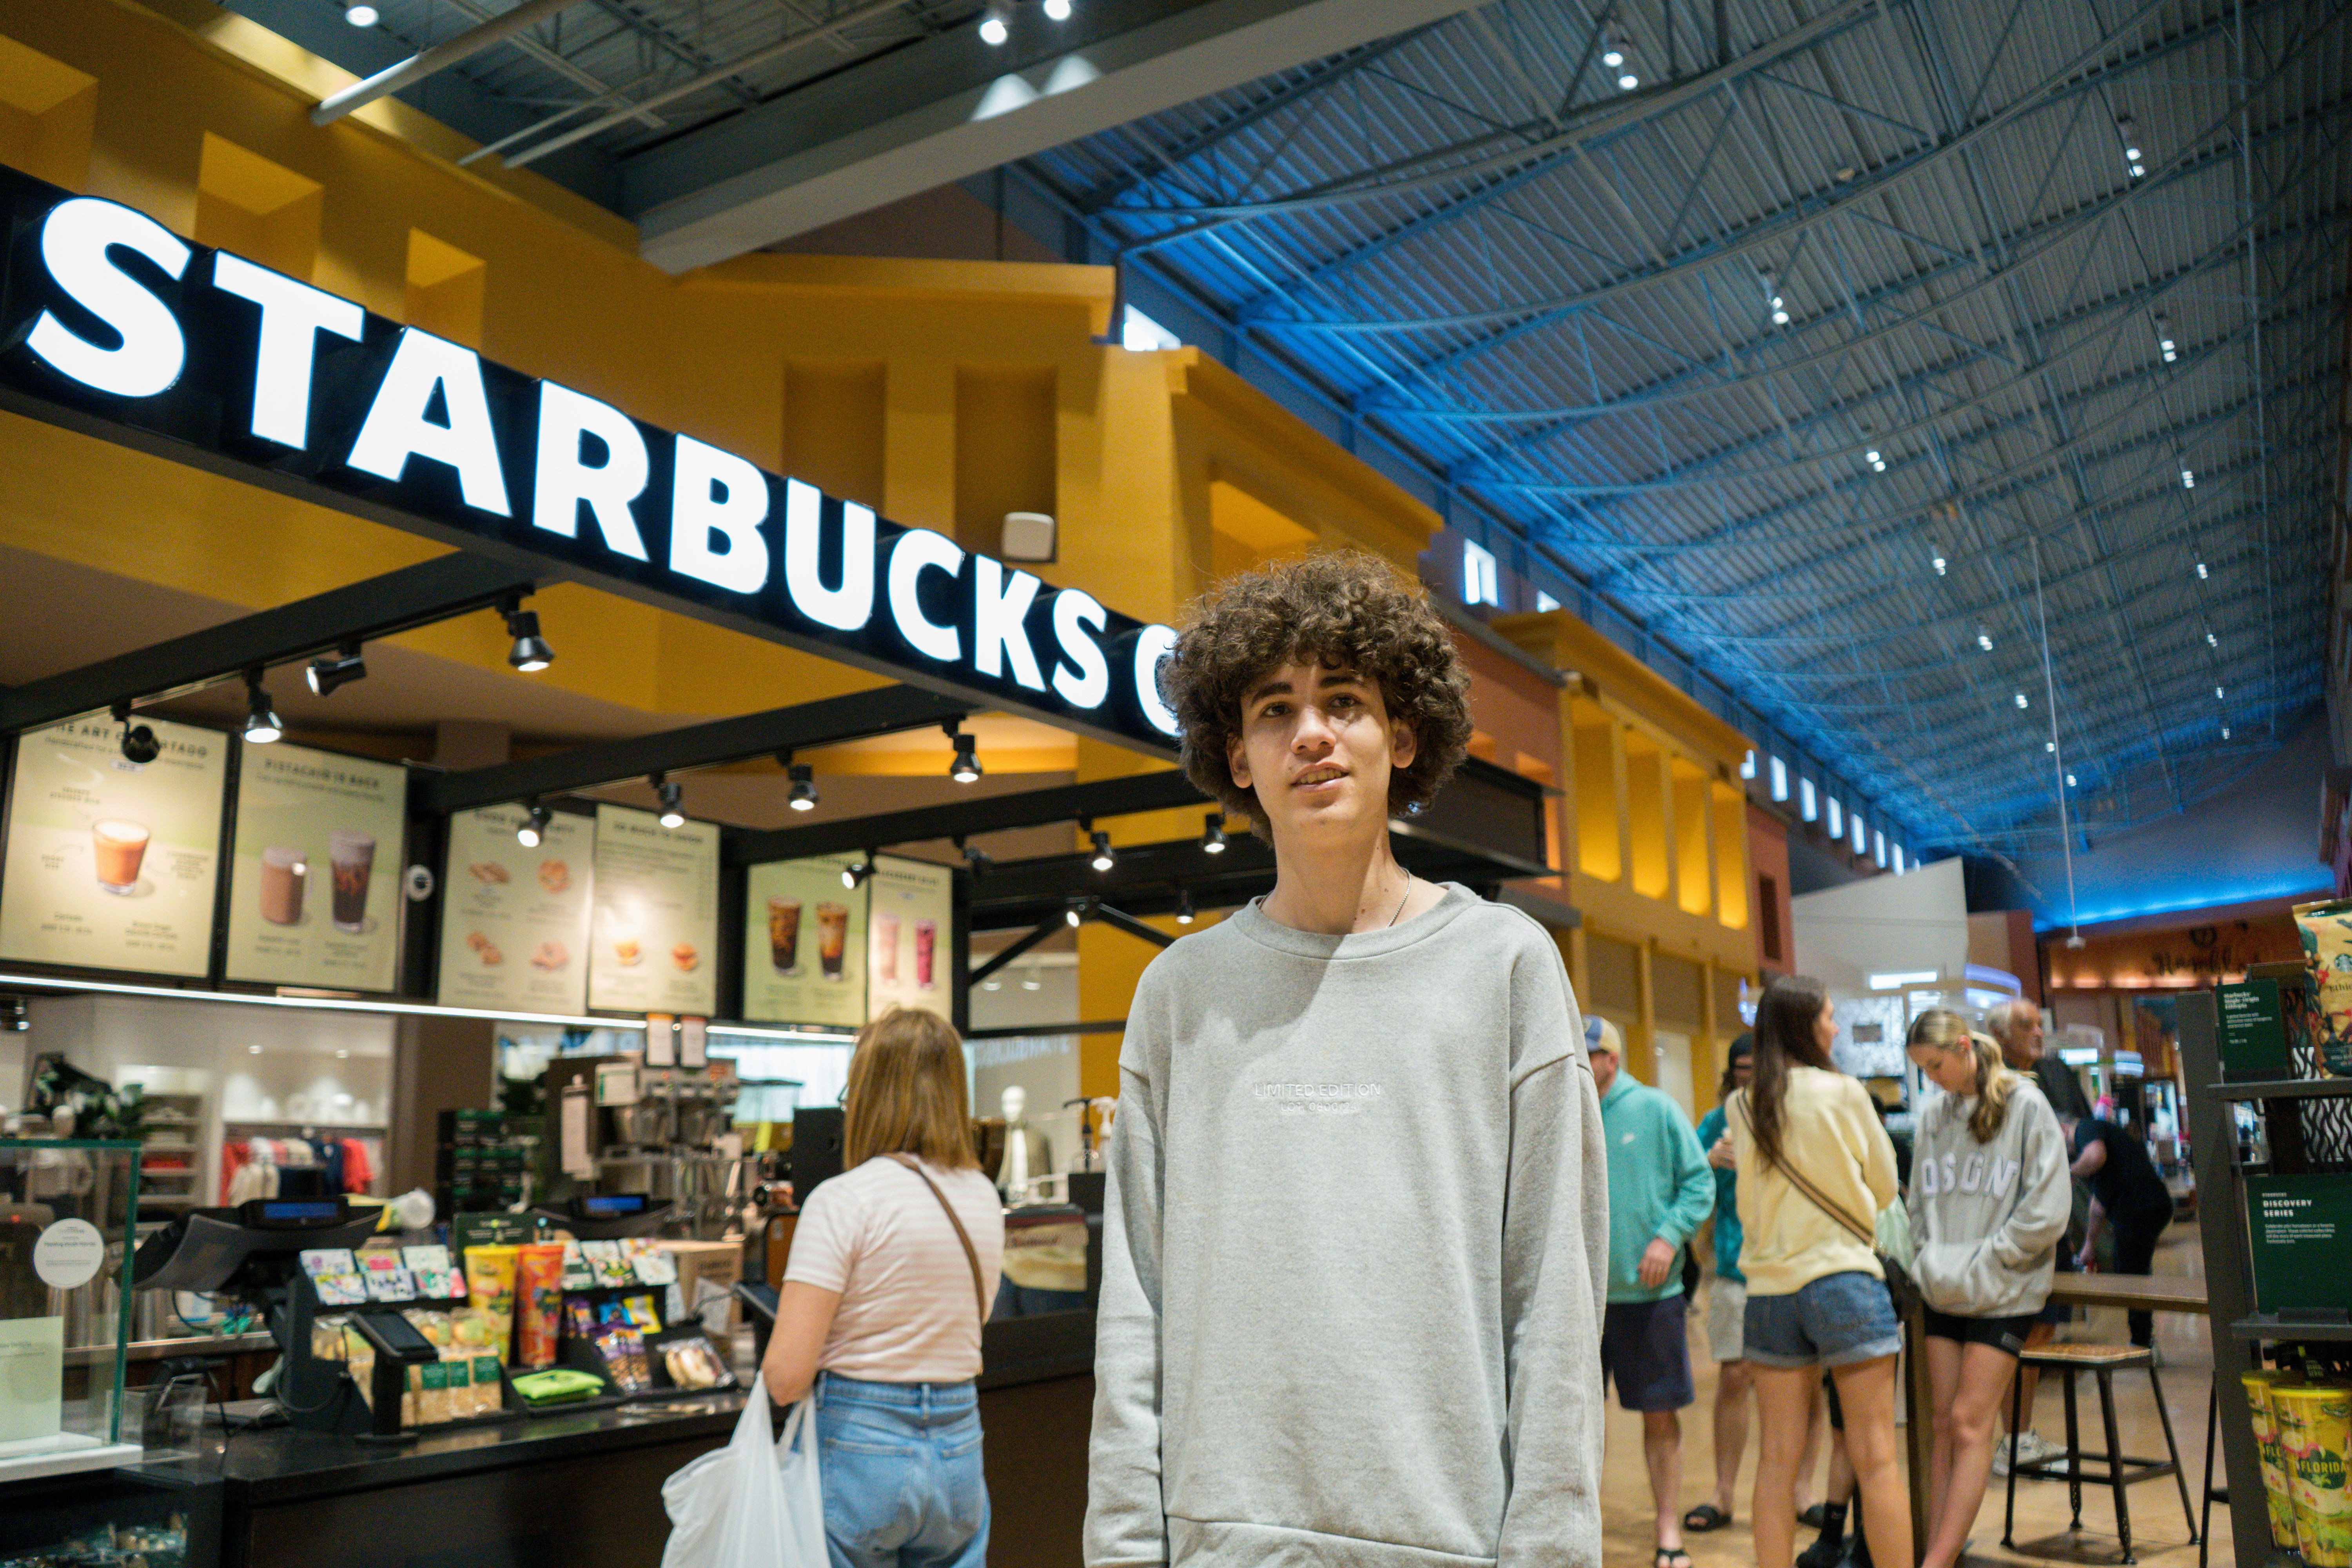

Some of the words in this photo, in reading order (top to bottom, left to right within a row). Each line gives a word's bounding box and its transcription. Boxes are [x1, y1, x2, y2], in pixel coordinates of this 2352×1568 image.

[26, 195, 1109, 709] STARBUCKS
[81, 725, 110, 740] ART
[1254, 1083, 1315, 1097] LIMITED
[1319, 1083, 1381, 1097] EDITION
[2262, 1199, 2312, 1208] DISCOVERY
[2263, 1209, 2294, 1218] SERIES
[2300, 1460, 2347, 1474] FLORIDA
